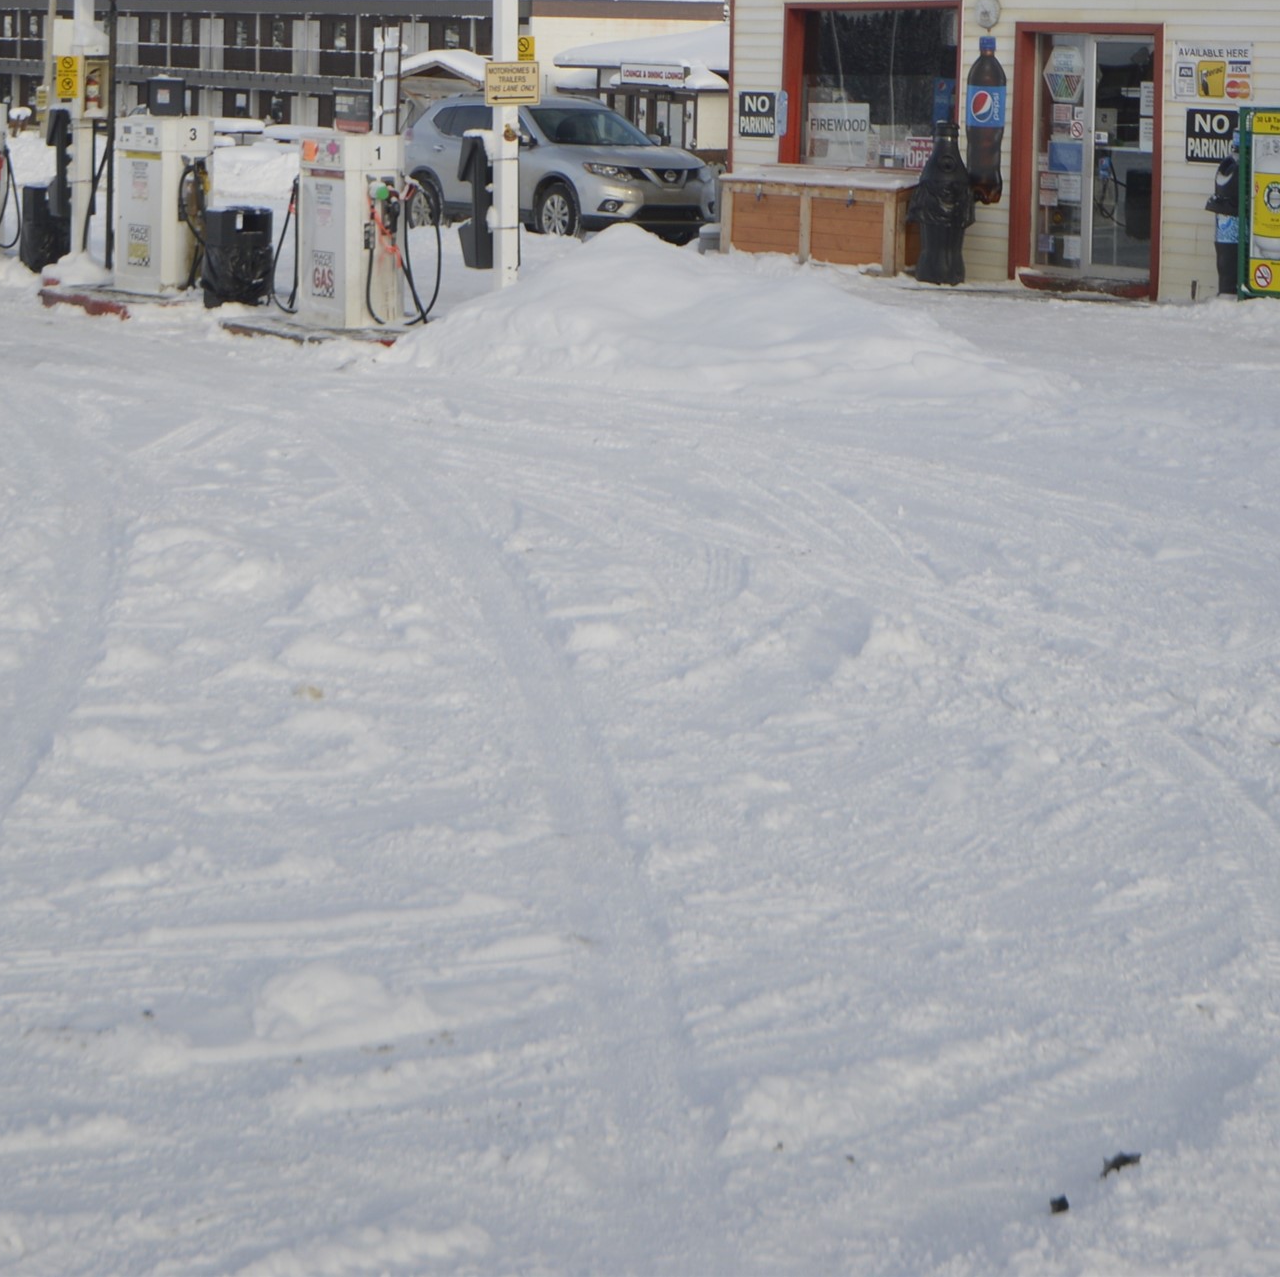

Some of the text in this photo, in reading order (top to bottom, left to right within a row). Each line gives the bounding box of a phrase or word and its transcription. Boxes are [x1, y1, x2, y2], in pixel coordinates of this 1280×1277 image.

[1179, 48, 1249, 58] AVAILABLE HERE
[1231, 65, 1248, 73] VISA
[744, 95, 770, 113] NO
[740, 116, 774, 134] PARKING
[810, 118, 867, 133] FIREWOOD
[1194, 113, 1230, 134] NO
[189, 128, 197, 141] 3
[375, 146, 381, 160] 1
[907, 150, 932, 167] OPE
[130, 226, 148, 234] RACE
[130, 233, 148, 242] TRAC
[313, 266, 334, 290] GAS
